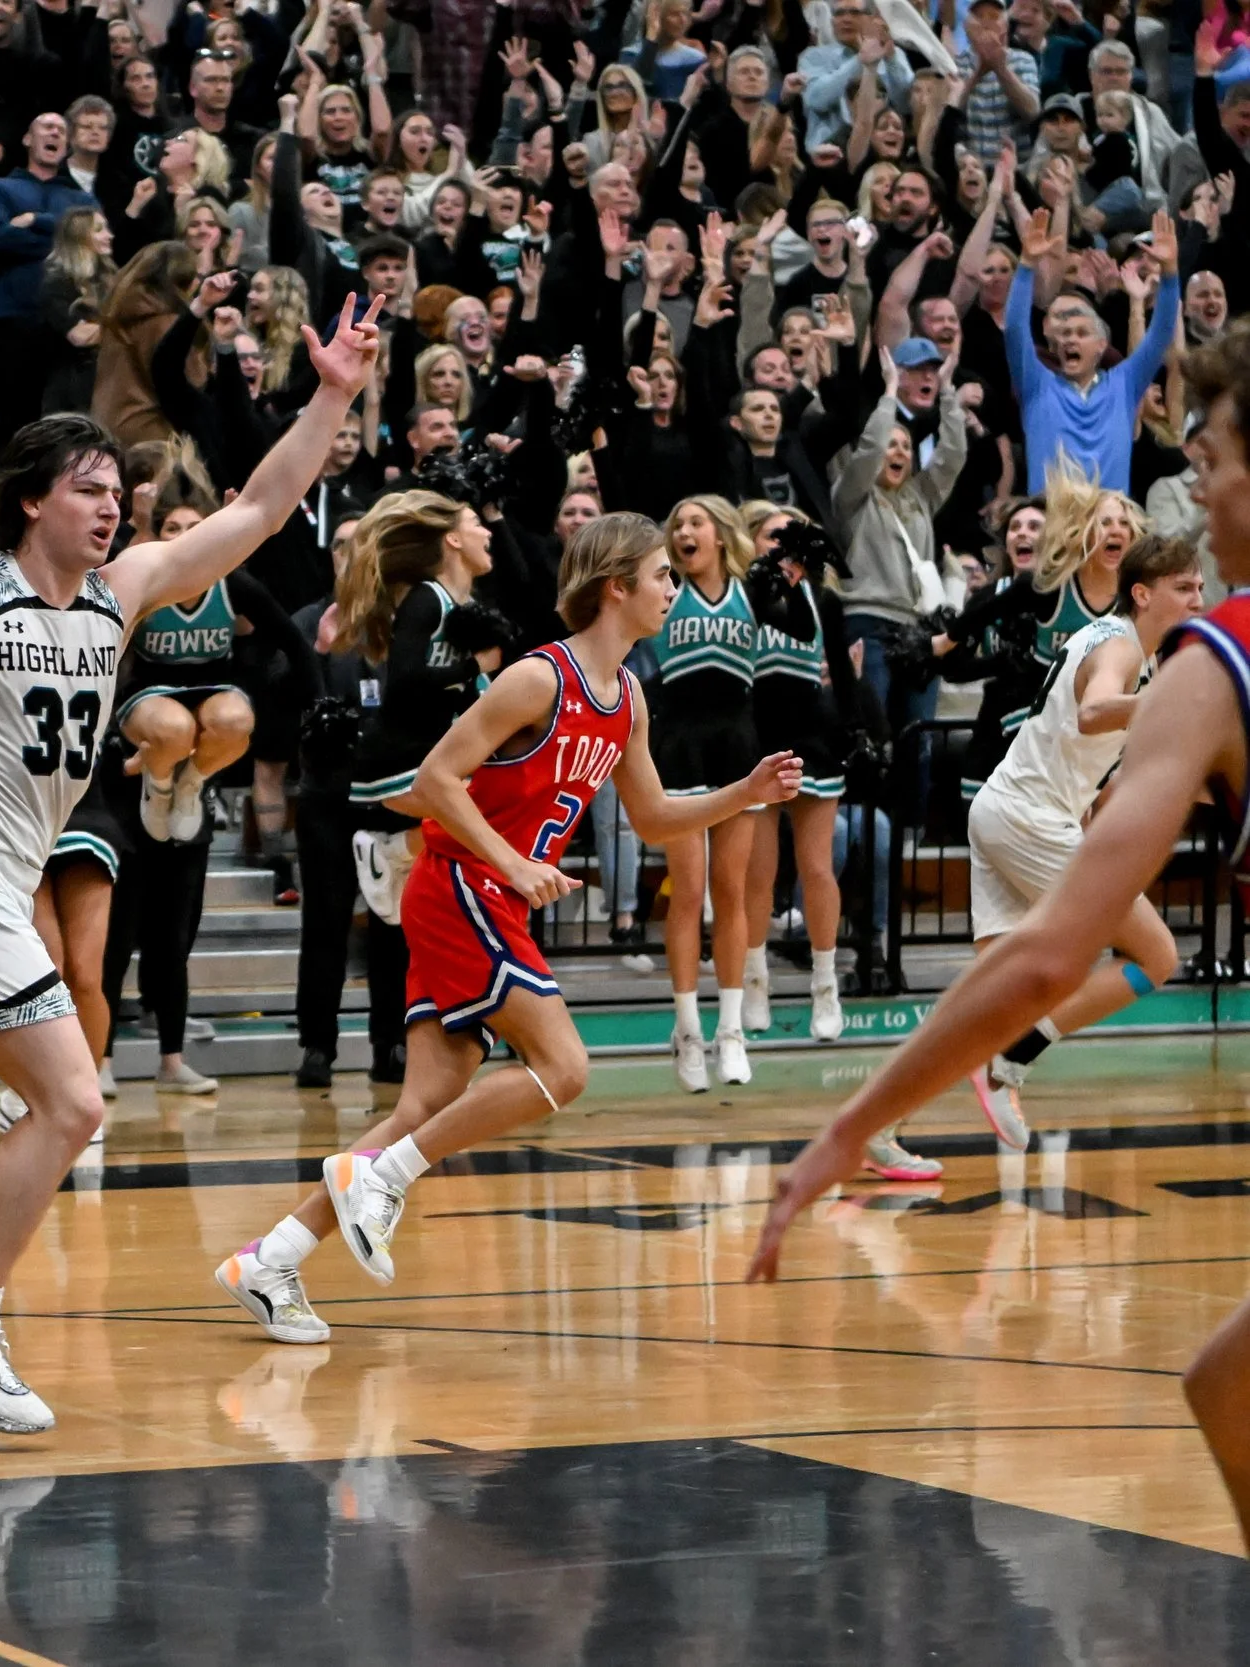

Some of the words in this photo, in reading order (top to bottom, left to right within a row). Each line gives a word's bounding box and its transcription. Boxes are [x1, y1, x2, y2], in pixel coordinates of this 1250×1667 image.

[144, 627, 230, 655] HAWKS
[669, 617, 752, 649] HAWKS
[22, 686, 101, 780] 33
[529, 790, 582, 862] 2
[884, 1008, 907, 1027] to
